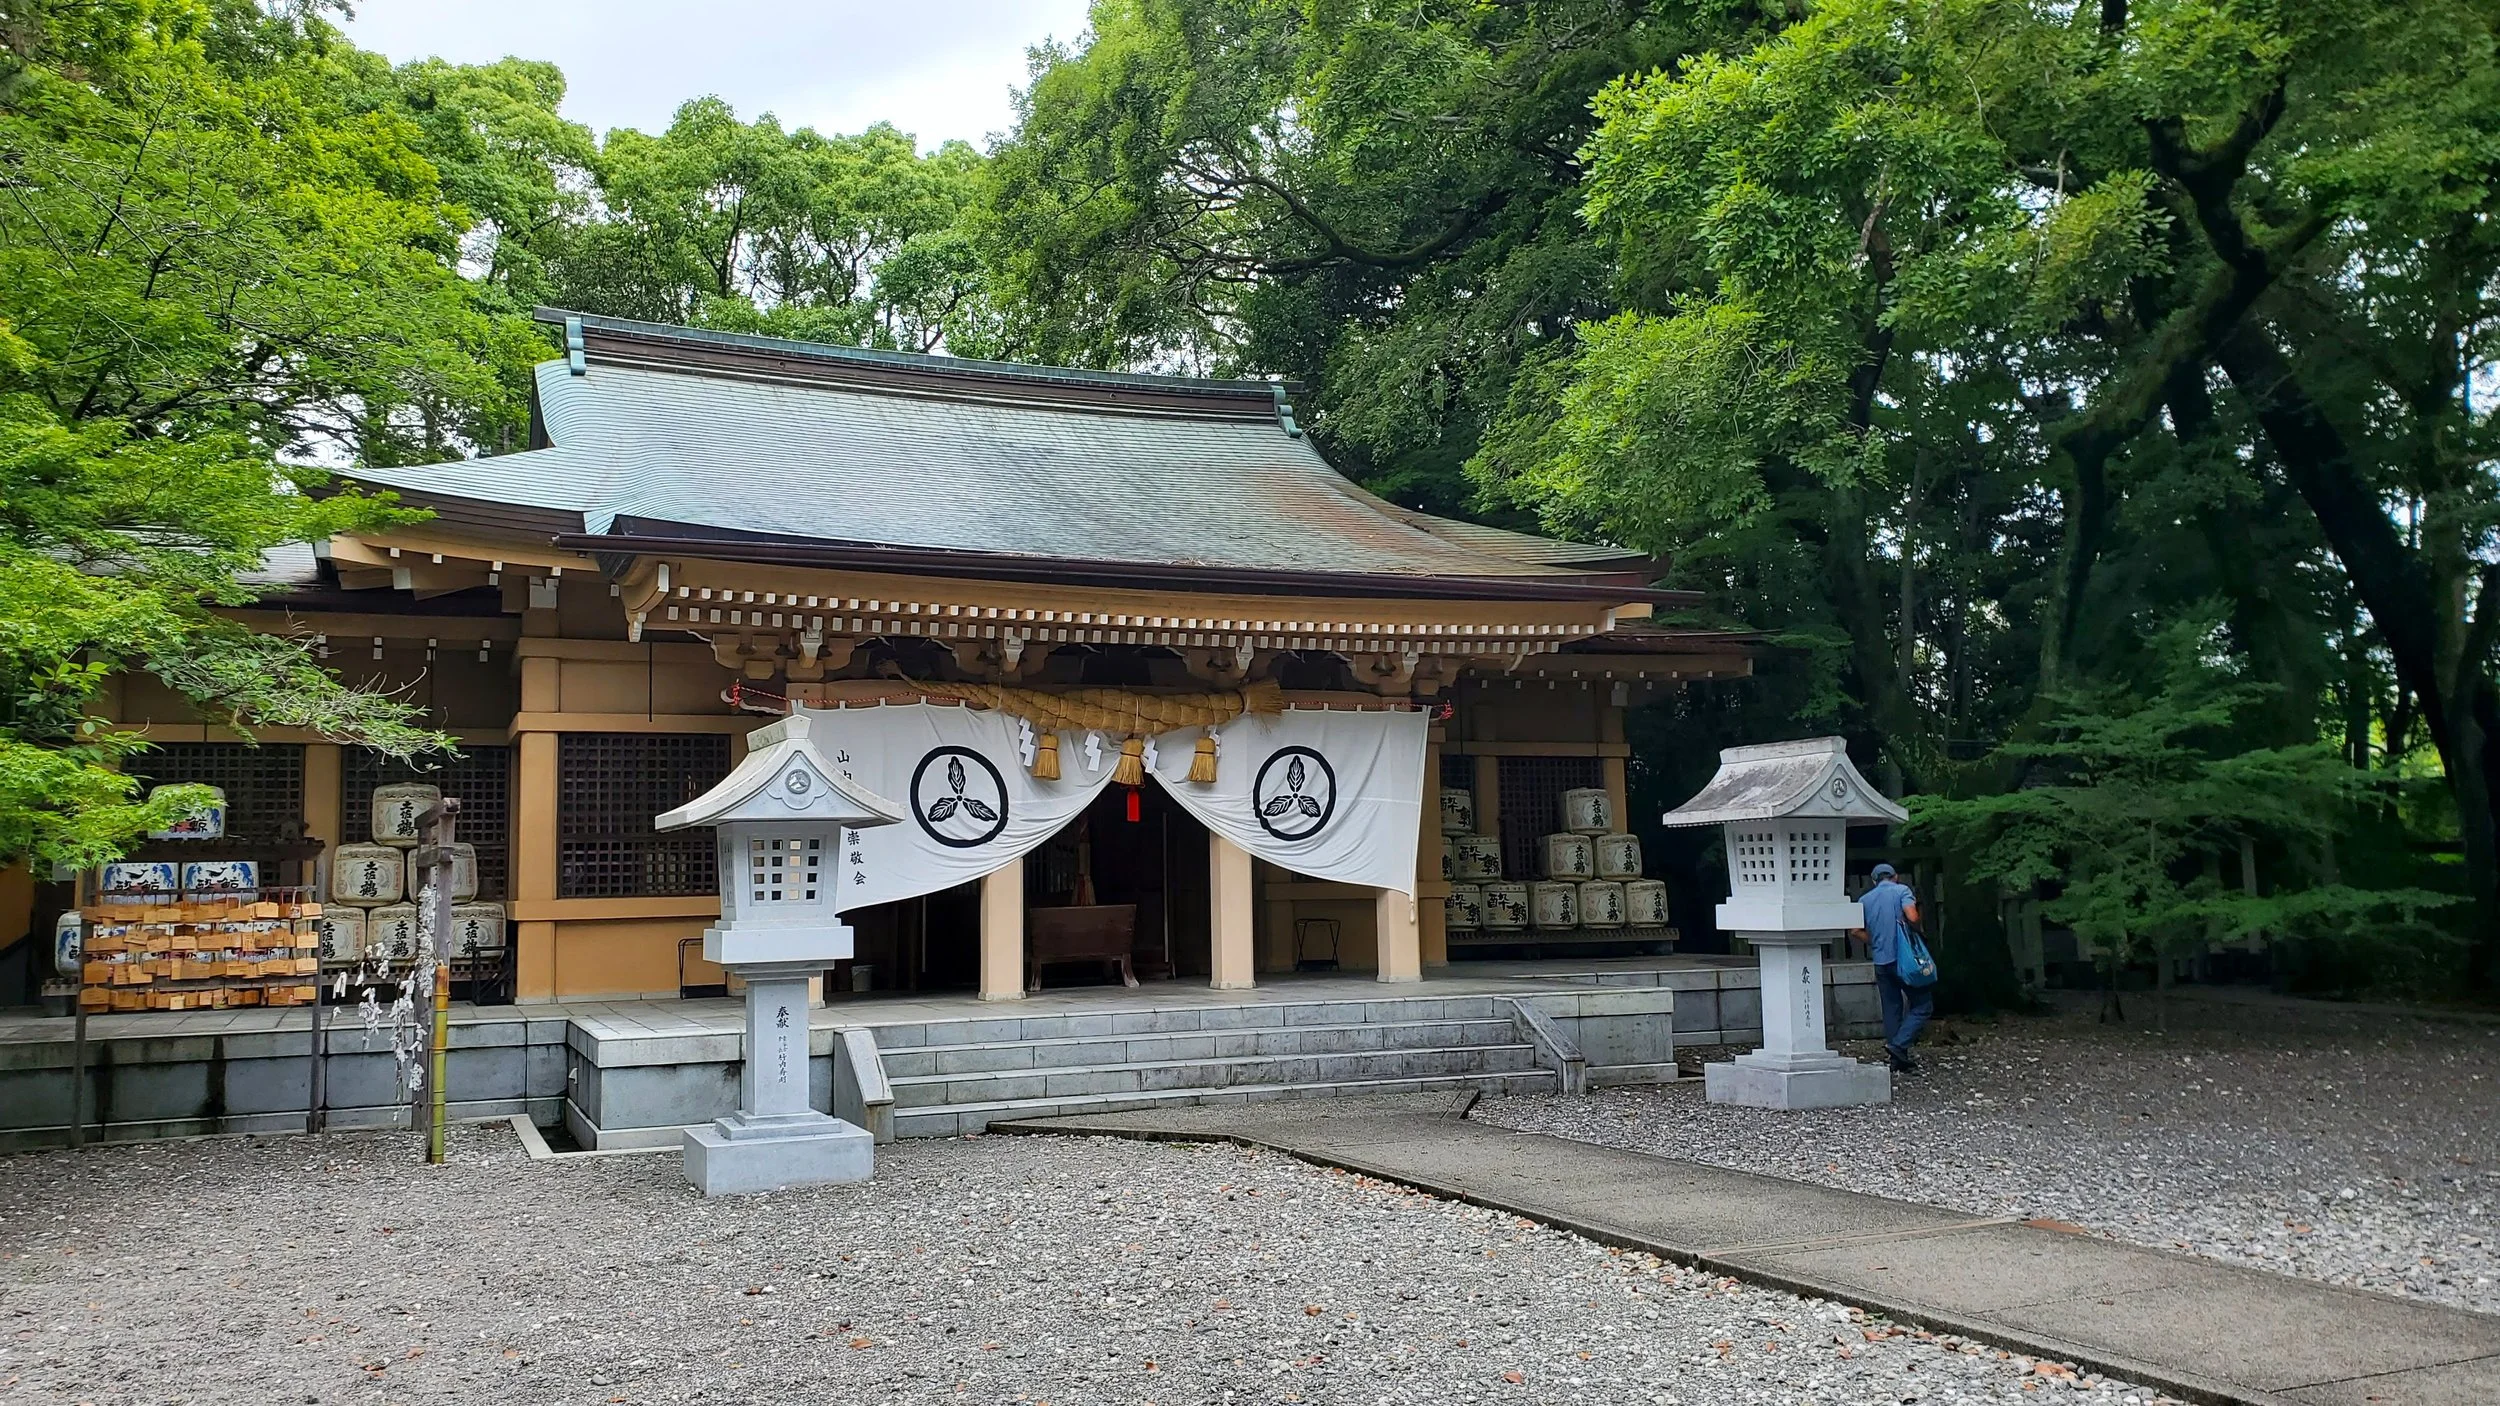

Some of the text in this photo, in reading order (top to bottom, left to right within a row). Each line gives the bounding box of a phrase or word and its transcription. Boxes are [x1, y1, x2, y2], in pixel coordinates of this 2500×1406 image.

[396, 801, 415, 837] 土佐鶴
[1592, 798, 1604, 828] 土佐鶴
[847, 830, 867, 885] 崇敬会
[1573, 844, 1586, 874] 土佐鶴
[1623, 843, 1635, 873] 土佐鶴
[359, 861, 378, 897] 土佐鶴
[390, 920, 411, 958] 土佐鶴
[776, 1005, 790, 1029] 奉献
